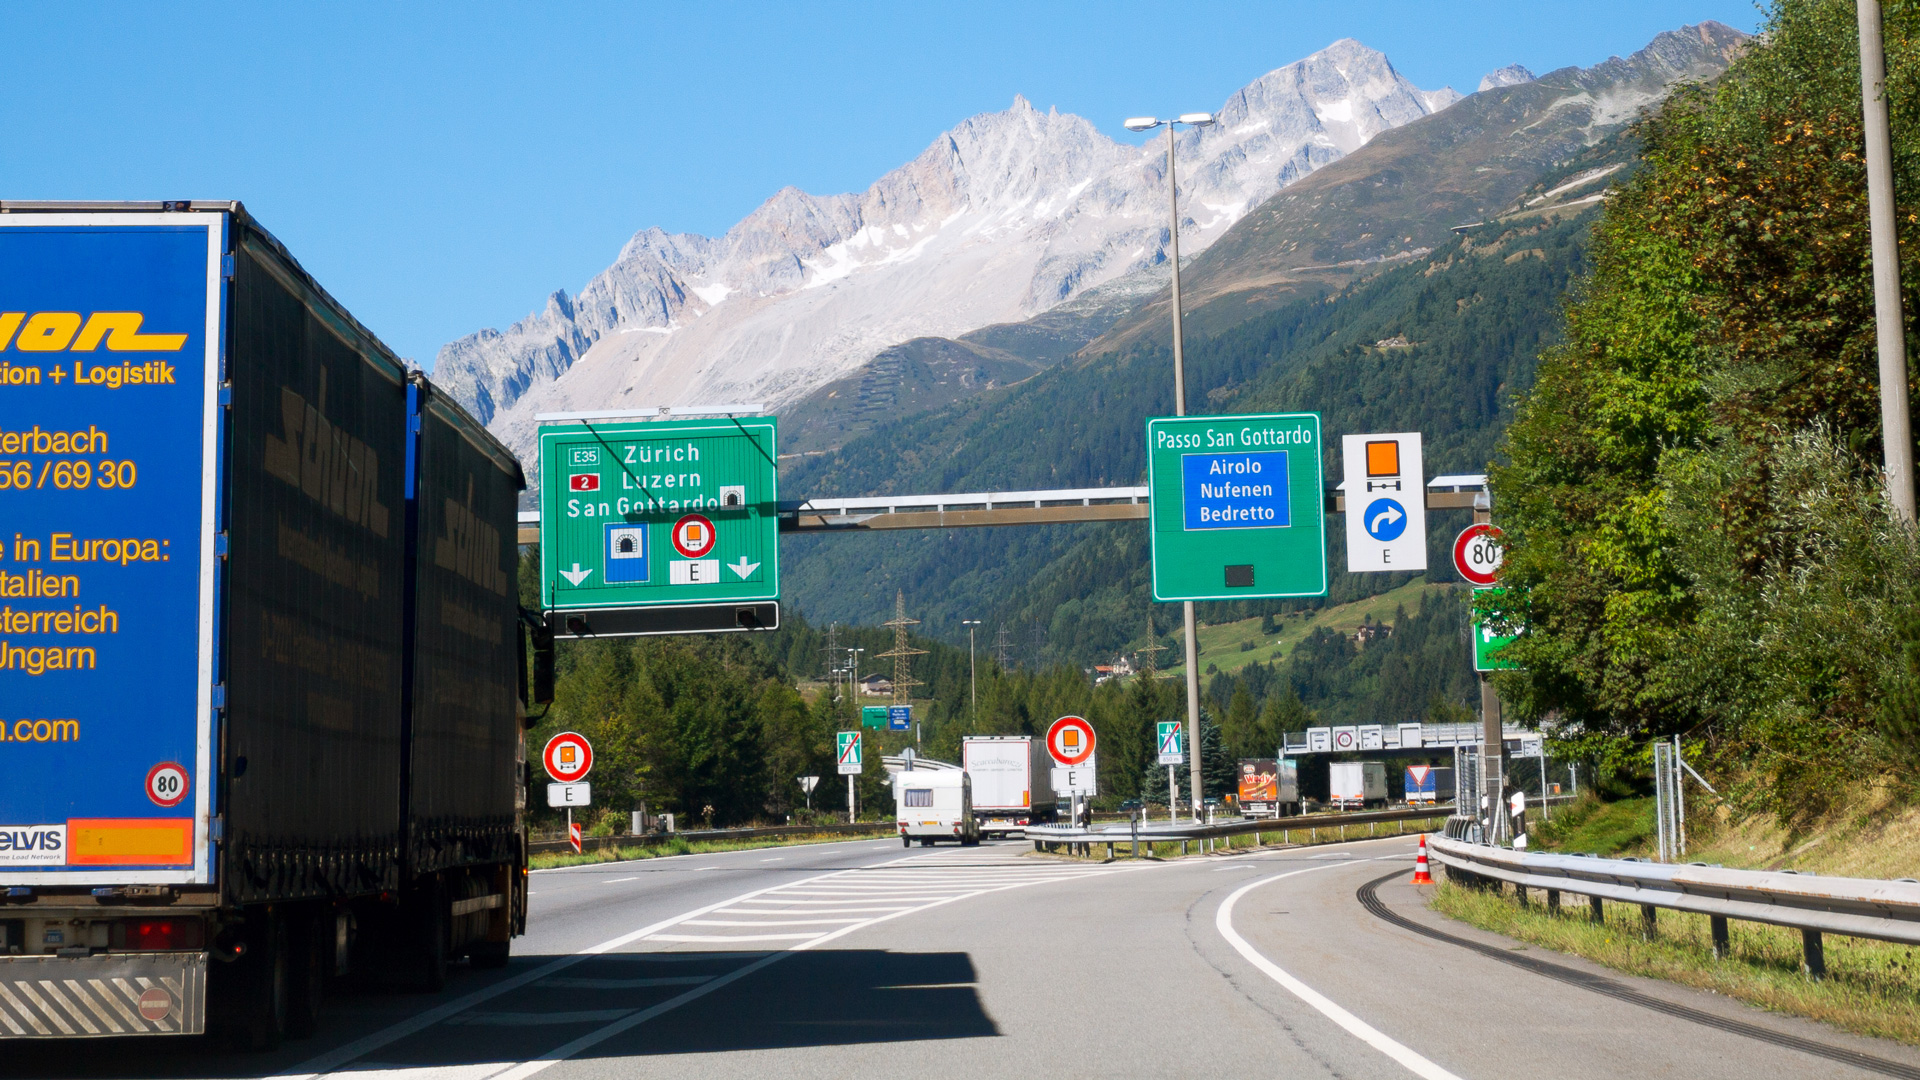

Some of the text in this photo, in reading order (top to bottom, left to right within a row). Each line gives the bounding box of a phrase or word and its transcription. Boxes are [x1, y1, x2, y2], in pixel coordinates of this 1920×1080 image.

[0, 361, 41, 384] ion
[74, 360, 175, 389] Logistik
[0, 425, 108, 453] erbach
[1157, 424, 1312, 449] Passo San Gottardo
[574, 451, 597, 463] E35
[624, 443, 699, 464] Zürich
[1209, 457, 1262, 476] Airolo
[580, 476, 590, 489] 2
[622, 471, 701, 490] Luzern
[1200, 481, 1273, 499] Nufenen
[567, 493, 718, 518] San Gottardo
[1200, 504, 1275, 522] Bedretto
[14, 533, 41, 562] in
[51, 532, 170, 566] Europa:
[1383, 548, 1392, 564] E
[1472, 543, 1496, 565] 80
[689, 564, 700, 582] E
[0, 604, 119, 634] terreich
[157, 776, 178, 793] 80
[1068, 771, 1077, 786] E
[565, 787, 573, 802] E
